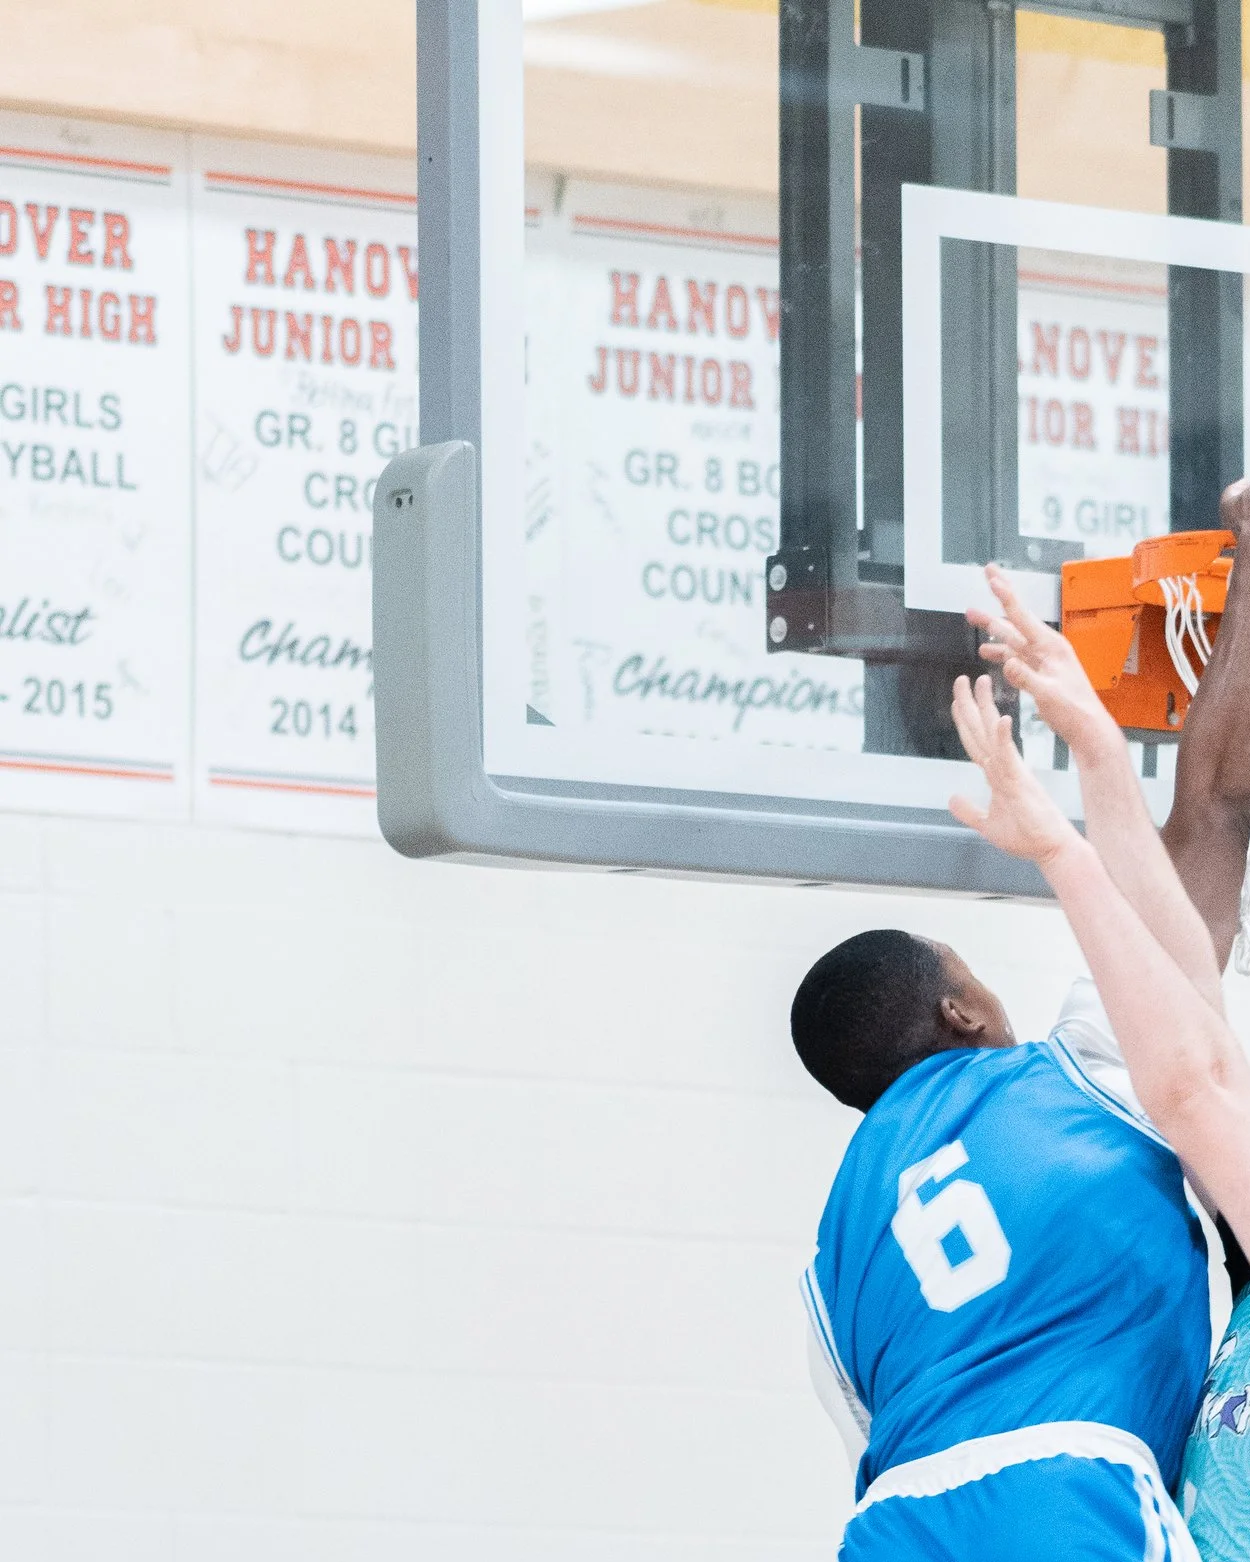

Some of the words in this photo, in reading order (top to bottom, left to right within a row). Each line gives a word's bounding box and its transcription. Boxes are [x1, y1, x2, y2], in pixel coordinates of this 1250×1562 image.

[44, 284, 157, 346] HIGH
[221, 304, 396, 373] JUNIOR
[587, 346, 757, 413] JUNIOR
[1019, 320, 1159, 390] NOVE
[0, 381, 122, 432] GIRLS
[253, 408, 324, 452] GR.
[337, 418, 359, 457] 8
[1019, 396, 1099, 452] IOR
[1114, 406, 1168, 459] HI
[623, 447, 693, 490] GR.
[704, 456, 724, 495] 8
[1041, 494, 1063, 533] 9
[1074, 497, 1168, 540] GIRL
[0, 595, 98, 647] list
[21, 676, 114, 721] 2015
[269, 696, 358, 740] 2014
[891, 1140, 1012, 1312] 6
